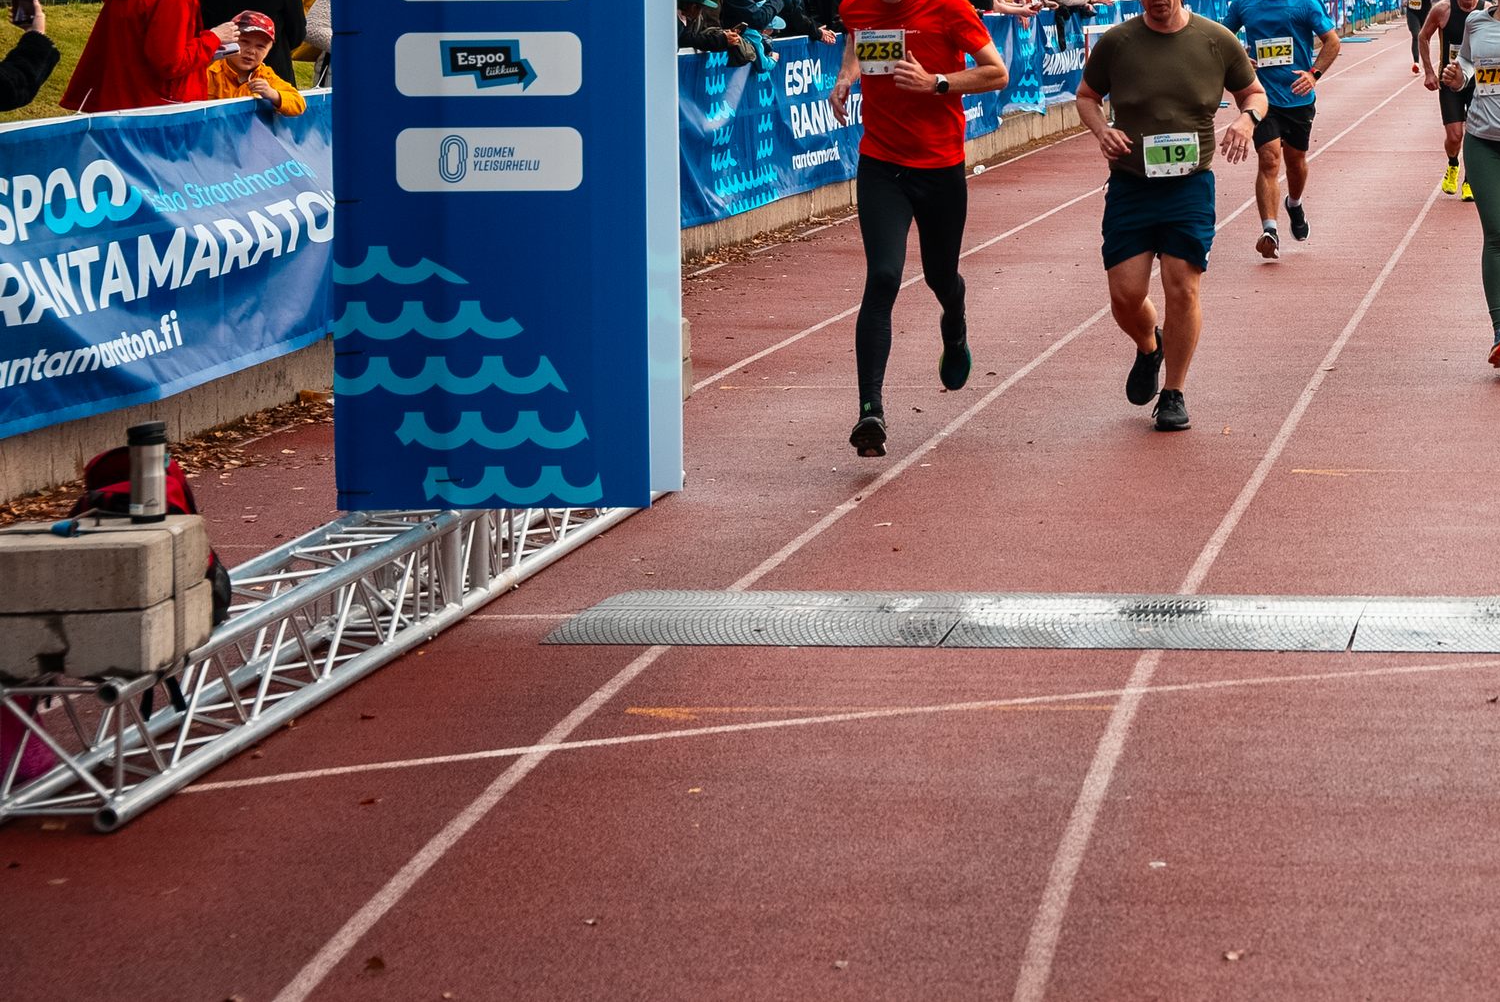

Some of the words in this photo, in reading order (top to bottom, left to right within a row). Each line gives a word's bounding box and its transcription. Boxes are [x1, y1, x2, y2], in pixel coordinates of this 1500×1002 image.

[857, 41, 903, 60] 2238
[1258, 44, 1292, 58] 1123
[456, 52, 505, 67] Espoo
[485, 64, 520, 77] liikkuu
[473, 146, 515, 158] SUOMEN
[1162, 145, 1186, 163] 19
[473, 159, 541, 172] YLEISURHEILU
[0, 189, 335, 327] RANTAMARATO
